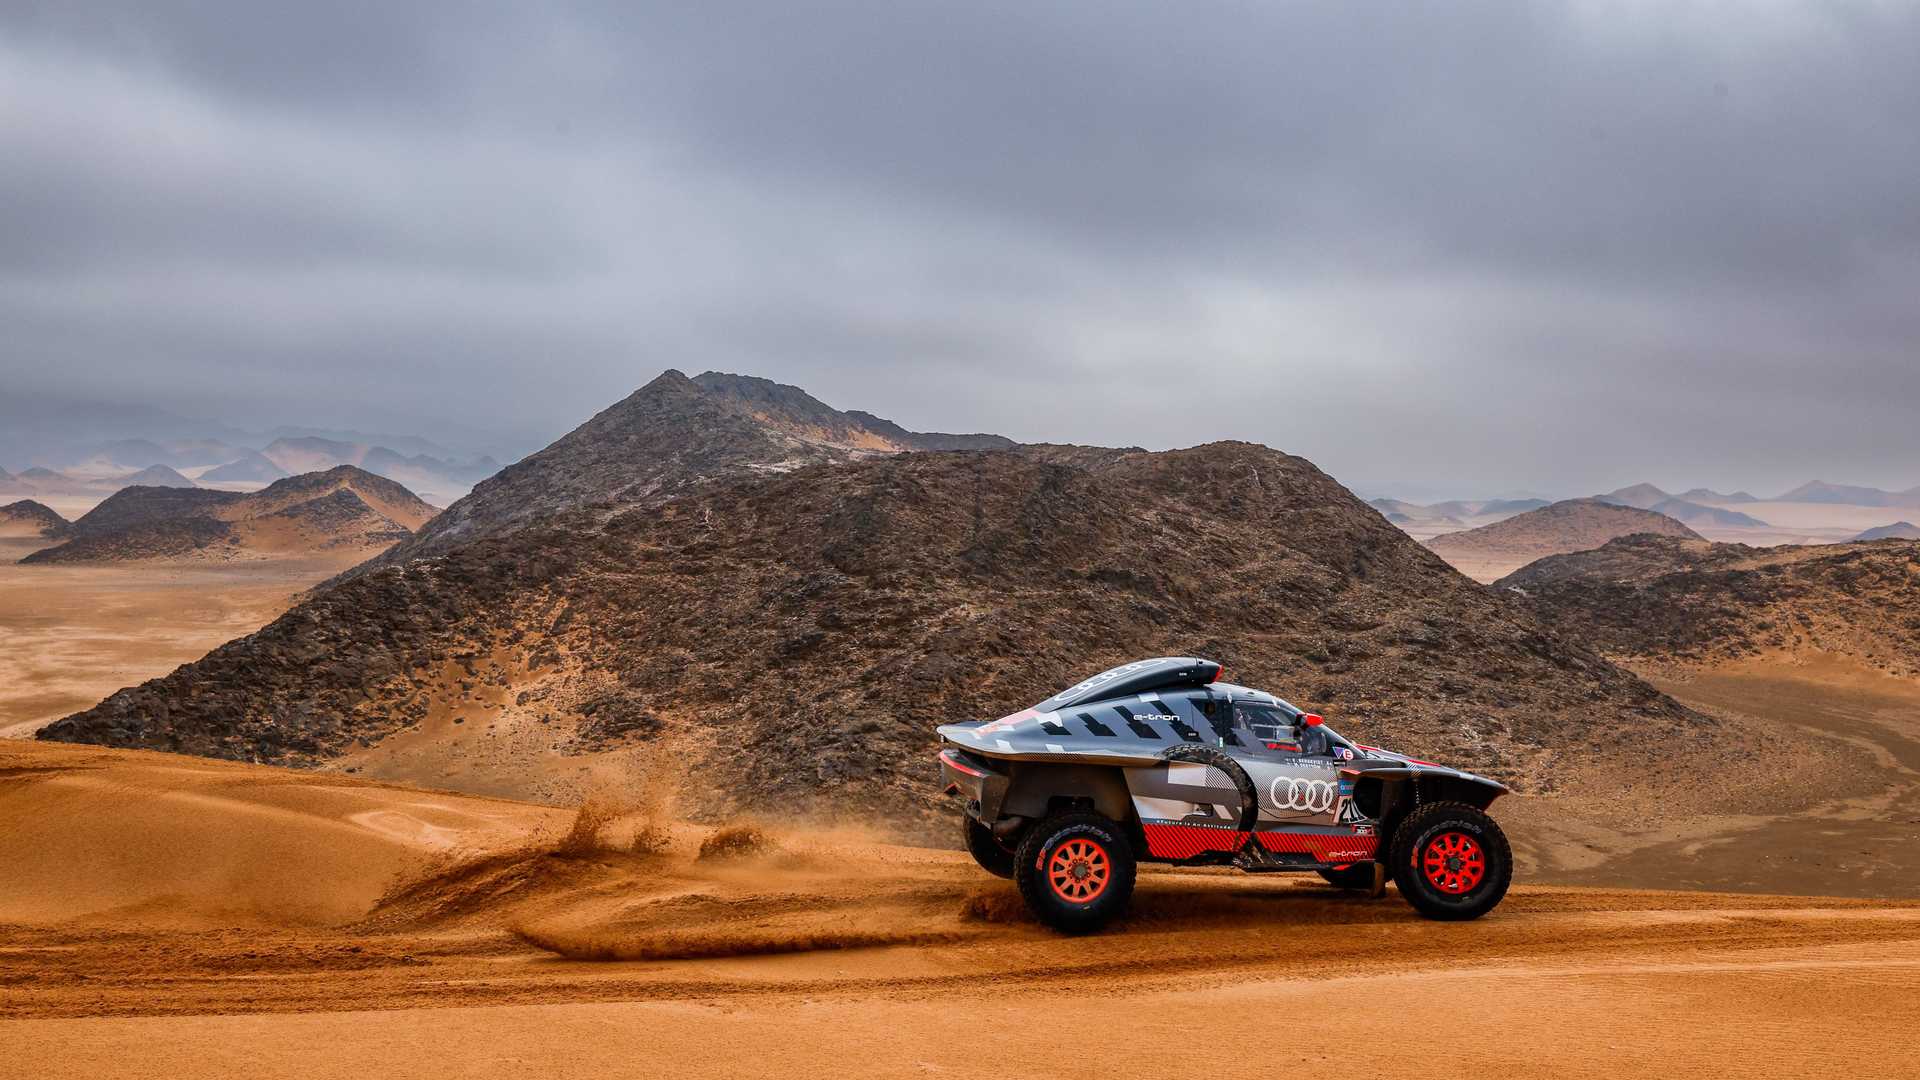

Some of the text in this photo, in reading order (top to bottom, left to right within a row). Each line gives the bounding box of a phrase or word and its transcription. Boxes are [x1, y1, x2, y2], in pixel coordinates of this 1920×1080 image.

[1133, 713, 1180, 721] e-tron
[1345, 751, 1352, 759] E
[1328, 850, 1368, 858] e-tron
